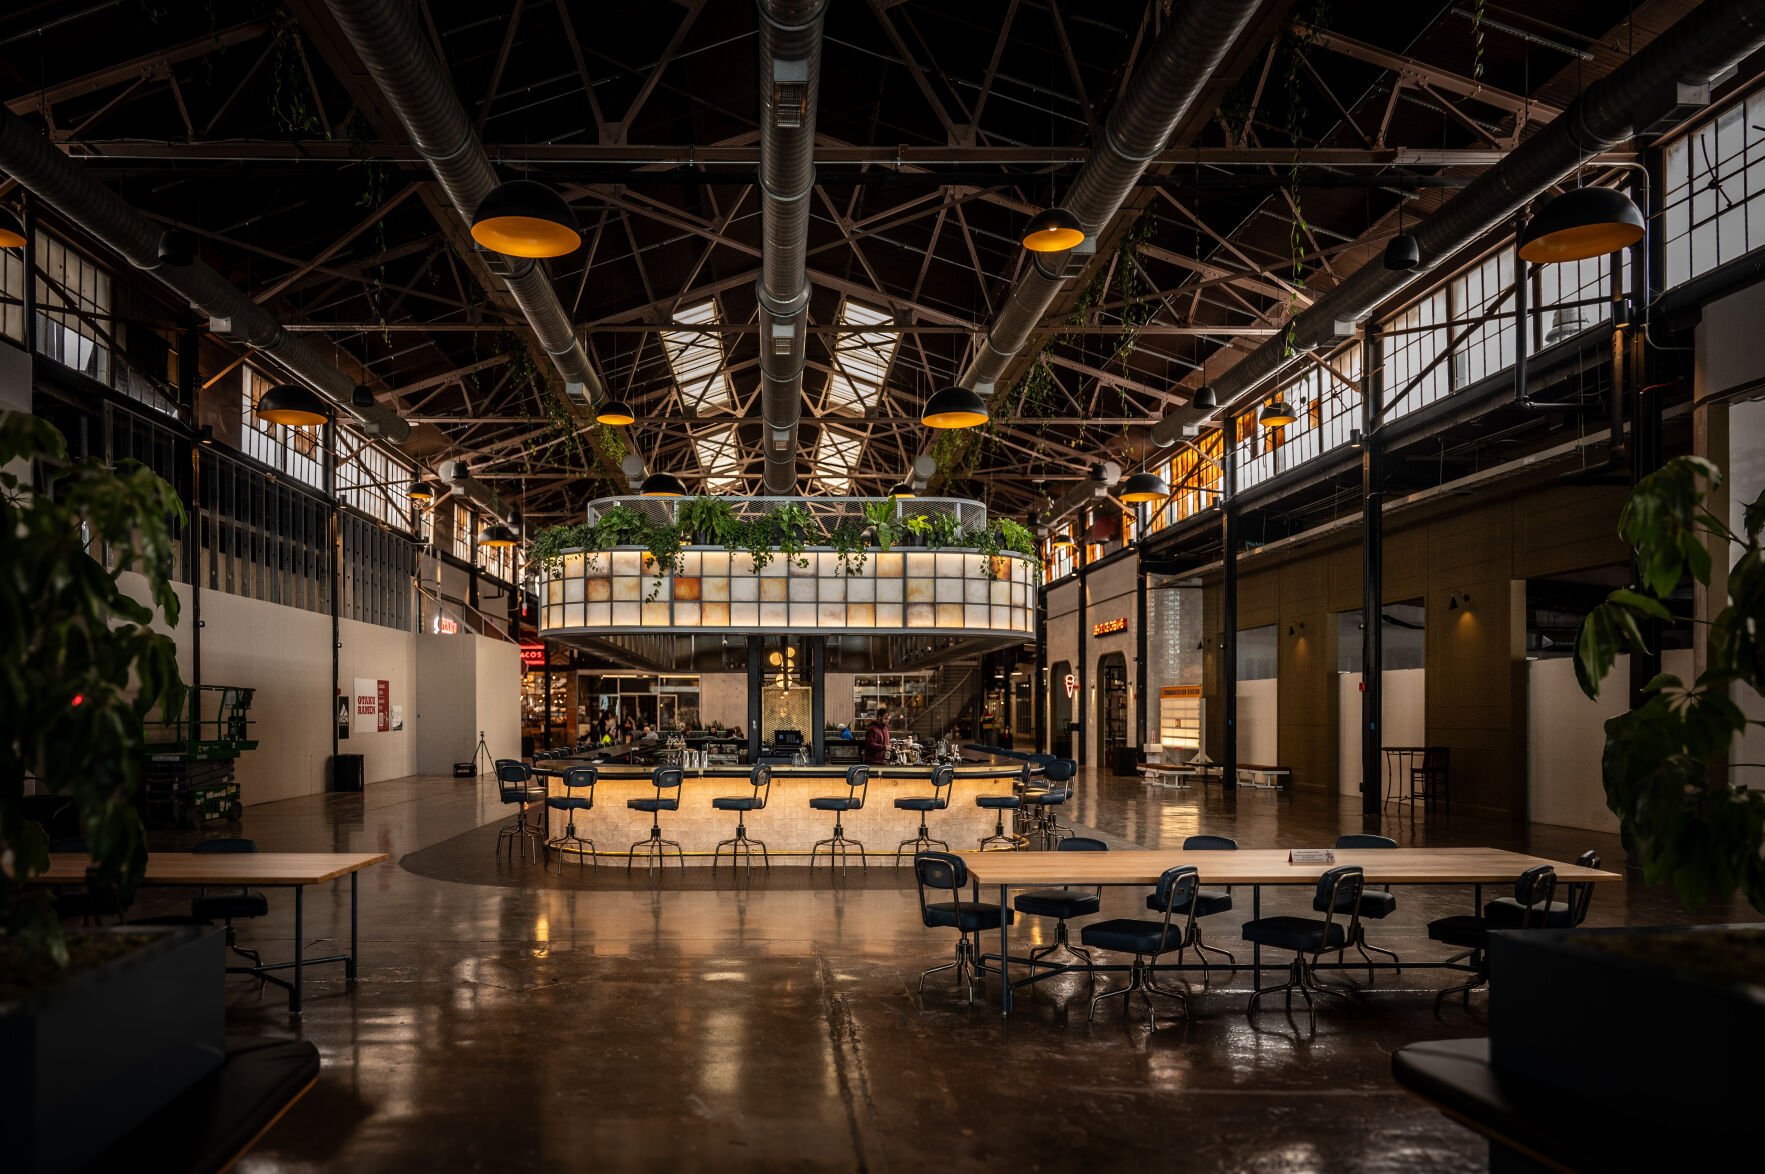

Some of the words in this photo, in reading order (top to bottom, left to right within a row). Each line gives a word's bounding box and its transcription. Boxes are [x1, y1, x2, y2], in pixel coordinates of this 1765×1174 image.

[520, 651, 542, 659] ACOS
[357, 696, 376, 705] OTAKU
[357, 705, 376, 715] RAMEN
